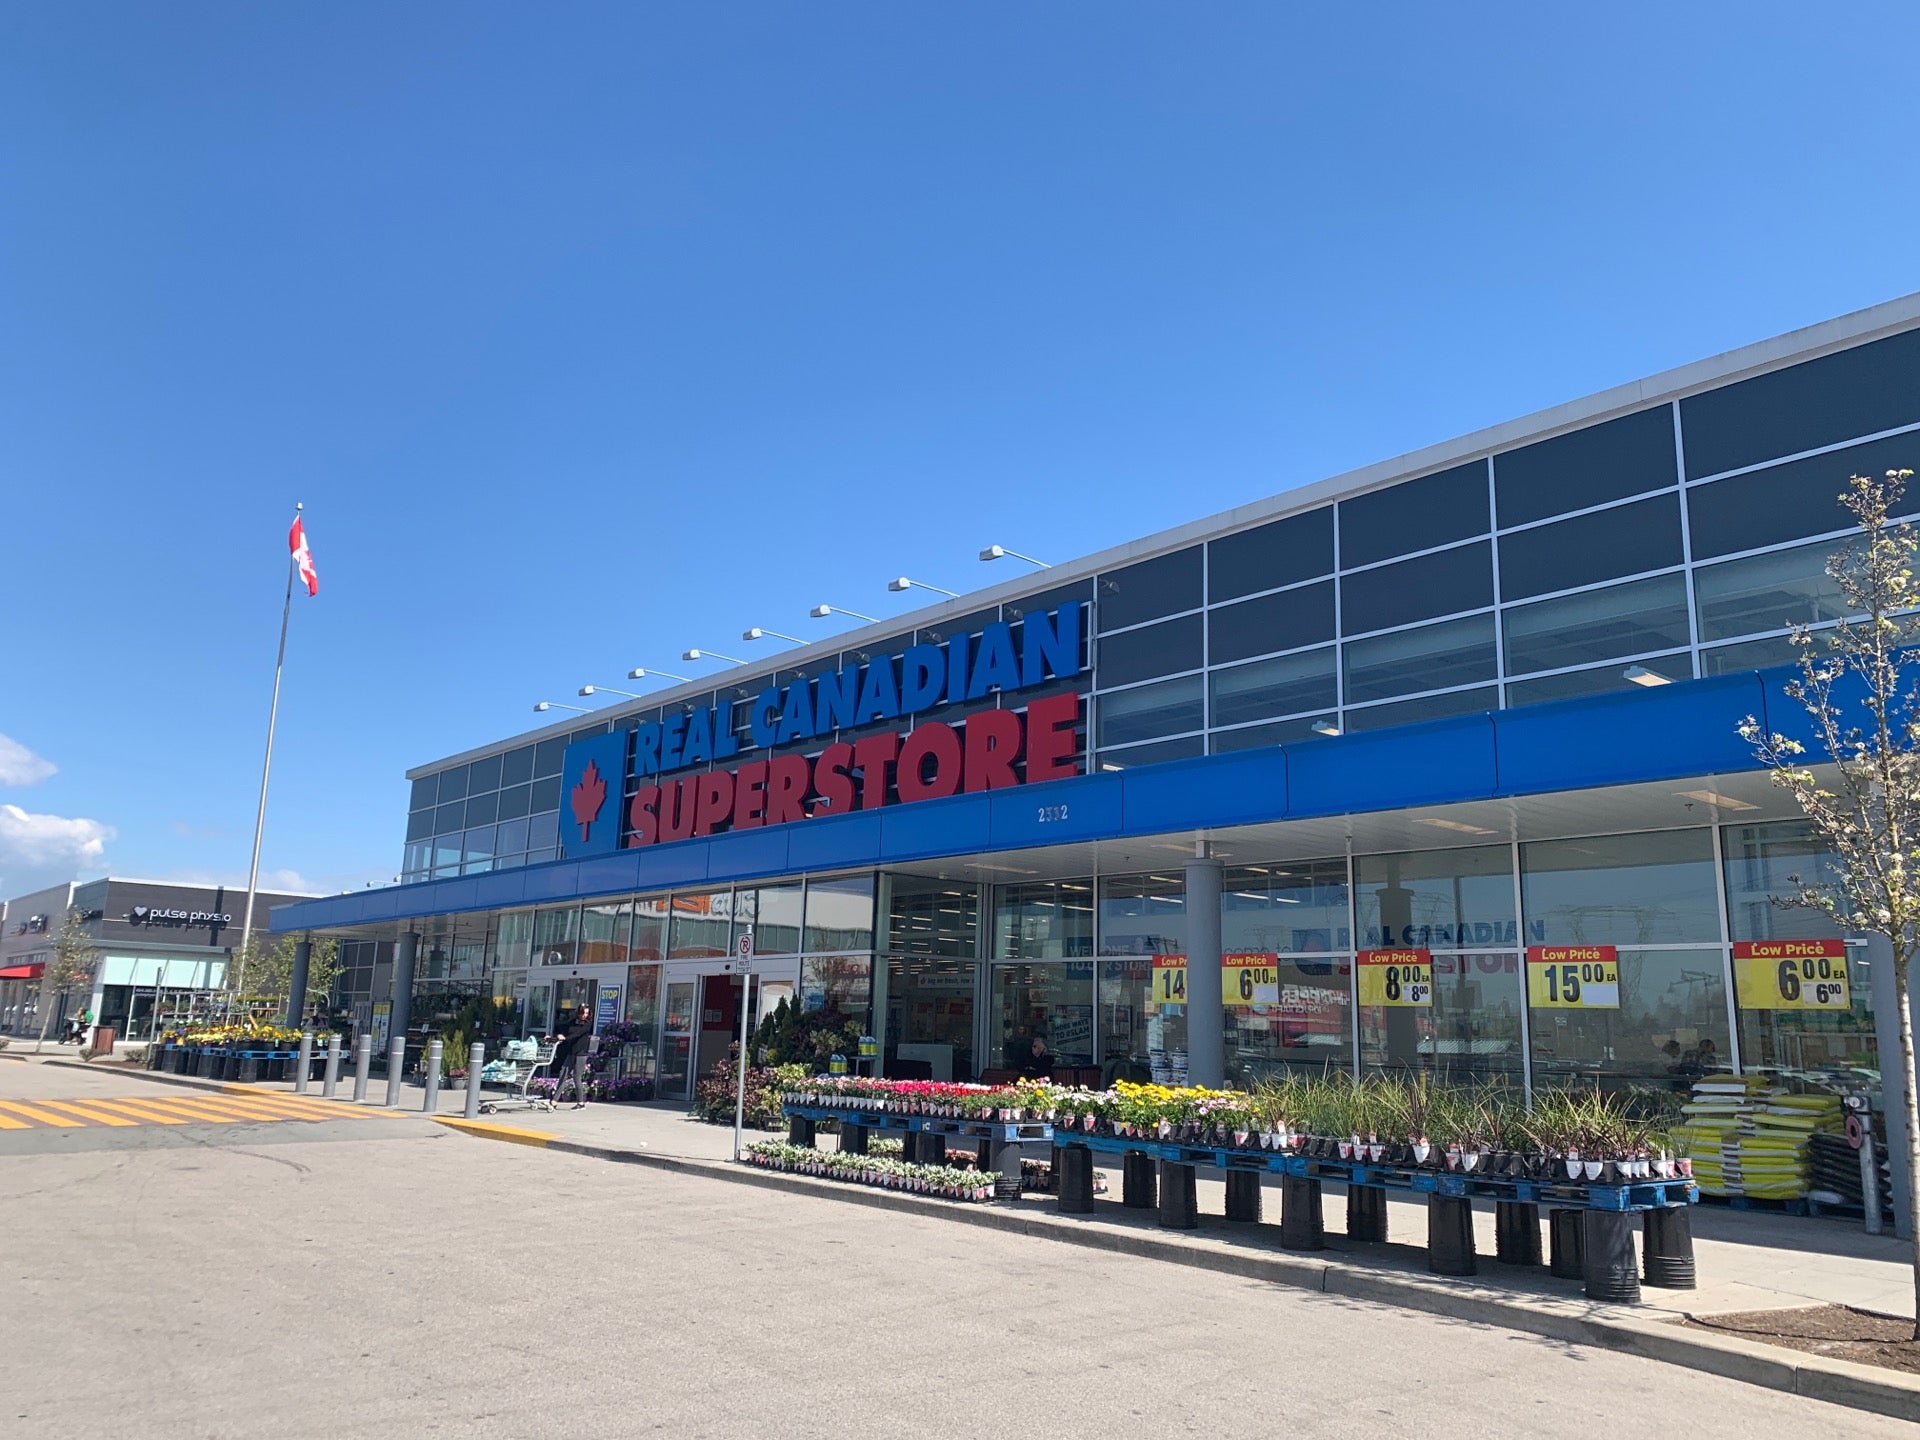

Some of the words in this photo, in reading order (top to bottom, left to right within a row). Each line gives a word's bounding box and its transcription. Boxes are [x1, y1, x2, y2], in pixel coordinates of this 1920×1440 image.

[634, 700, 739, 776] REAL
[750, 601, 1080, 748] CANADIAN
[628, 692, 1078, 848] SUPERSTORE
[150, 908, 187, 921] pulse
[1337, 926, 1395, 946] RAL
[1402, 920, 1545, 945] CANADIAN
[1541, 949, 1566, 960] Low
[1569, 948, 1600, 960] Price
[1751, 944, 1781, 956] Low
[1785, 943, 1825, 955] Price
[1161, 956, 1177, 966] Low
[1226, 955, 1244, 965] Low
[1245, 955, 1267, 965] Price
[1369, 952, 1389, 963] Low
[1391, 952, 1418, 963] Price
[1606, 973, 1616, 982] EA
[1833, 970, 1846, 979] EA
[601, 990, 618, 1000] STOP
